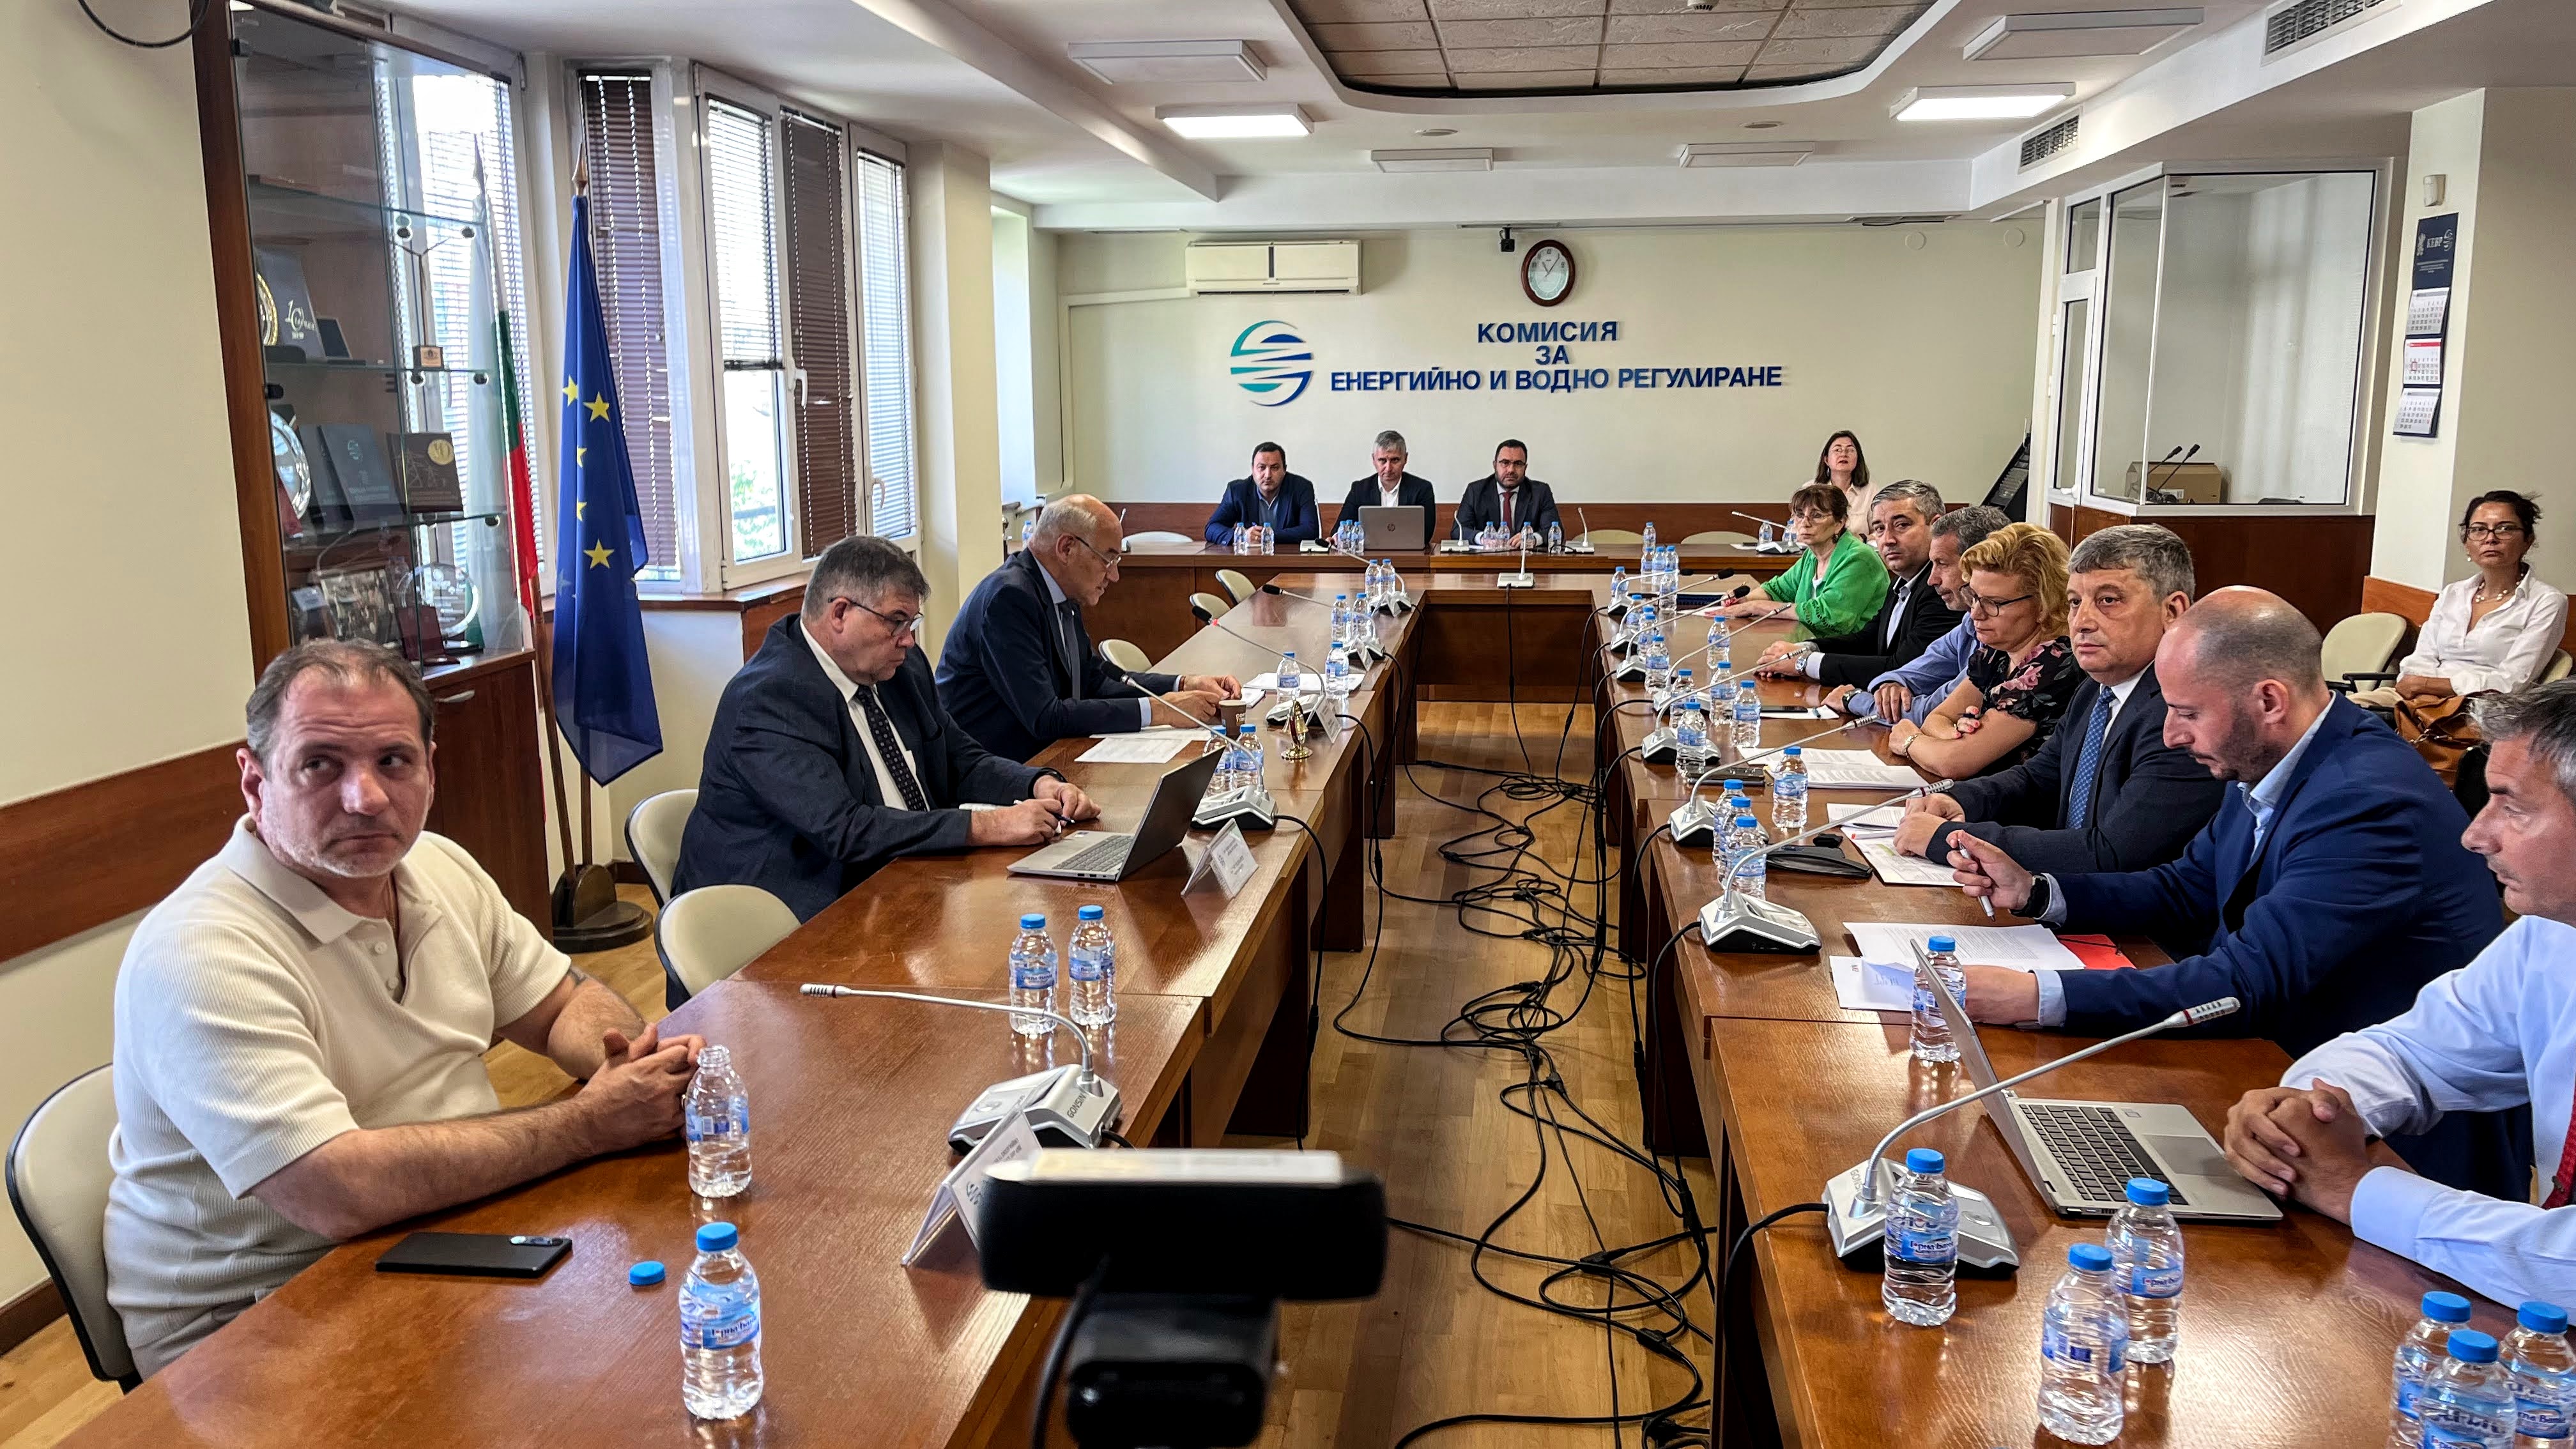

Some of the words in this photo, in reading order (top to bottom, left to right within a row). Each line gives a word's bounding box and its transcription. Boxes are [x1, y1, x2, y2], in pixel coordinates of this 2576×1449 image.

[1478, 321, 1617, 343] КОМИСИЯ
[1535, 345, 1570, 365] ЗА
[1331, 366, 1481, 391] ЕНЕРГИЙНО
[1491, 370, 1506, 390] И
[1515, 369, 1609, 393] ВОДНО
[1618, 365, 1782, 388] РЕГУЛИРАНЕ
[1067, 1093, 1086, 1118] GONSIN
[1850, 1169, 1862, 1195] GONSI
